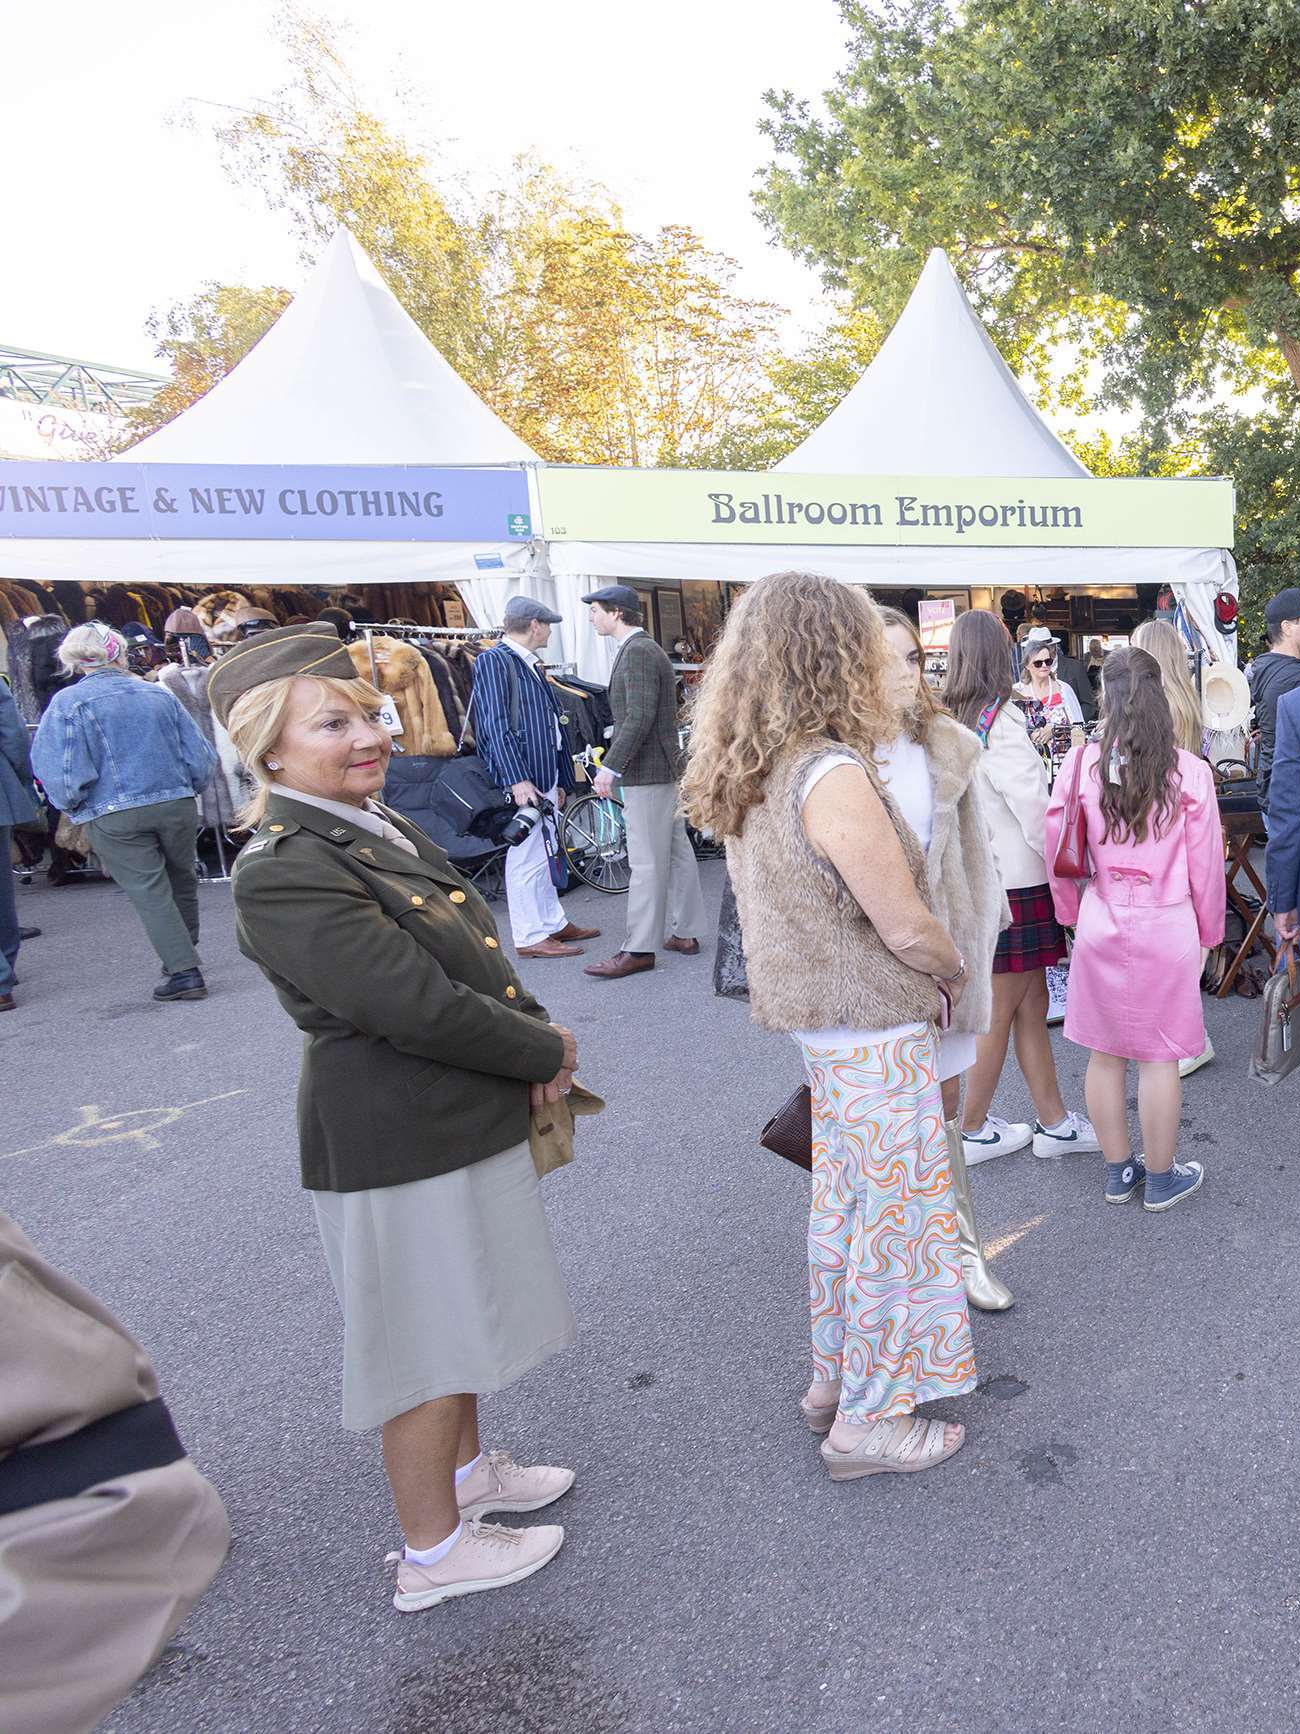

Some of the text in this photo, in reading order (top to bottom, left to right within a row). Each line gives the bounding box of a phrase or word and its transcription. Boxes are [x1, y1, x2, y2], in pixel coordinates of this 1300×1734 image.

[0, 486, 444, 518] INTAGE & NEW CLOTHING
[707, 493, 1084, 534] Ballroom Emporium
[550, 526, 568, 536] 103
